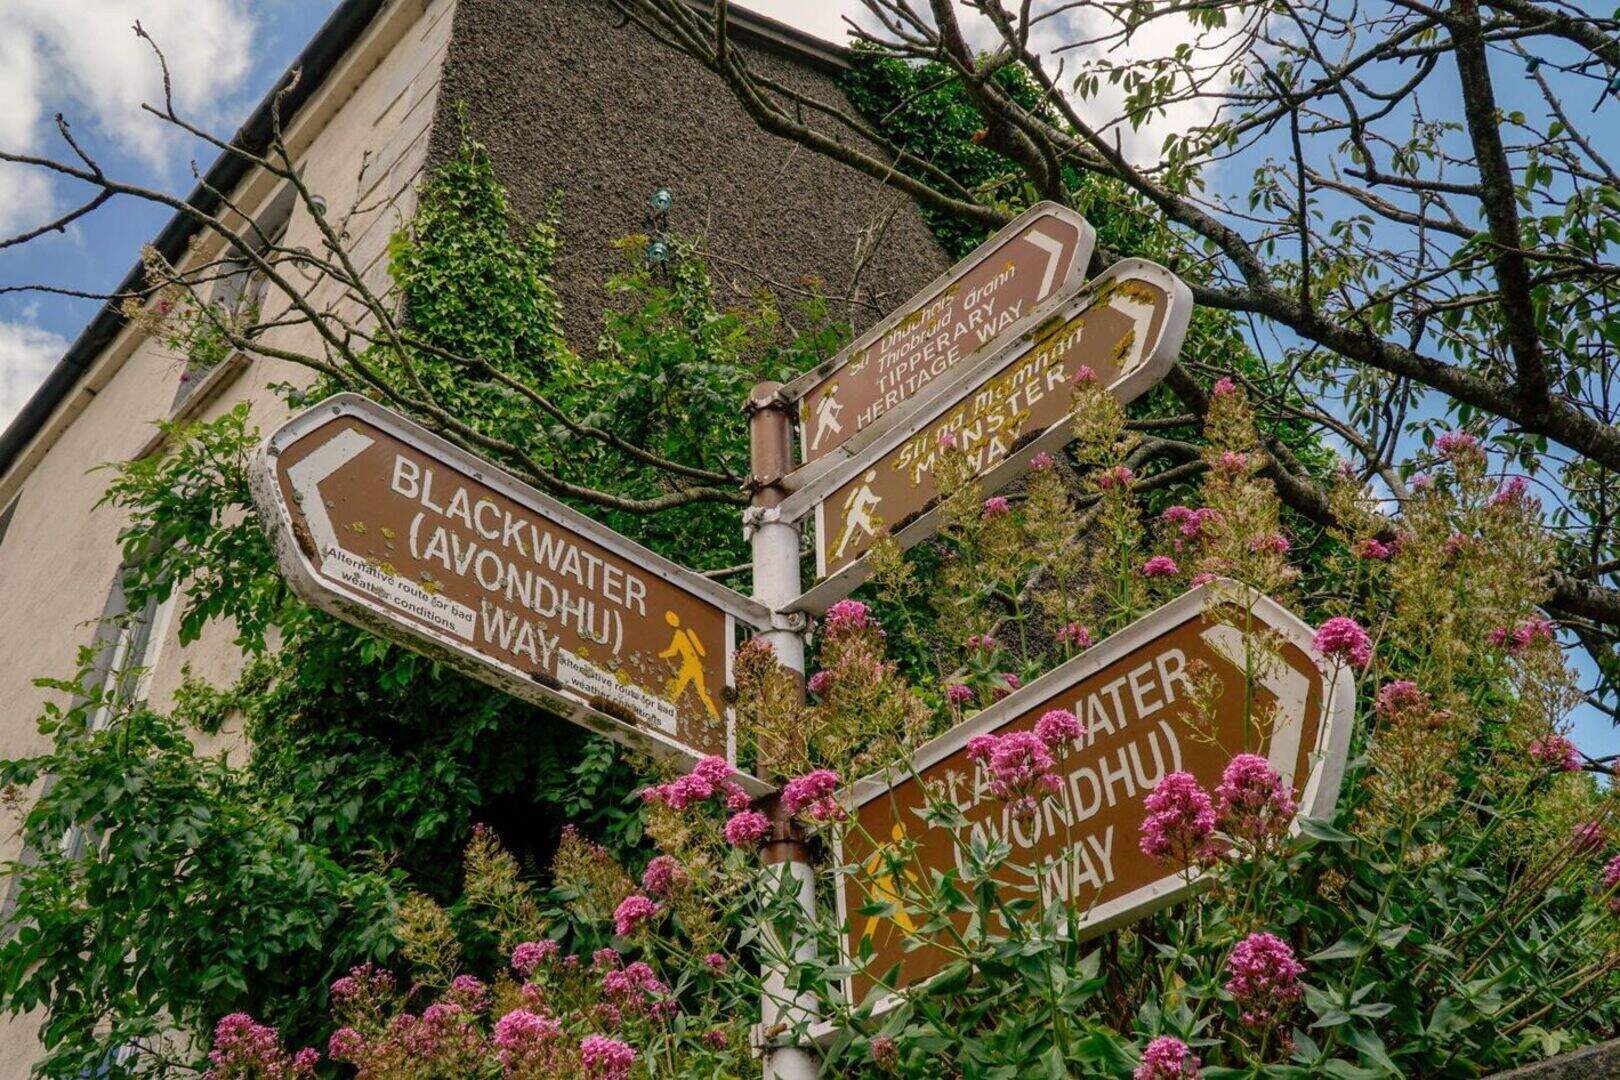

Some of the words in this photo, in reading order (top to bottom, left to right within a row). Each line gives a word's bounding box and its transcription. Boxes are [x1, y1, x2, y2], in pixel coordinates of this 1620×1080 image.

[857, 345, 961, 430] HERITAGE
[976, 300, 1023, 344] WAY
[877, 298, 996, 394] TIPPERARY
[916, 364, 1066, 484] MNSTER
[391, 454, 647, 616] BLACKWATER
[328, 548, 395, 586] Alternative
[398, 582, 429, 602] route
[451, 604, 473, 622] bad
[341, 571, 391, 600] weatr
[409, 512, 623, 655] (AVONDHU)
[481, 601, 560, 671] WAY
[560, 658, 612, 687] Altertive
[1031, 826, 1115, 910] WAY
